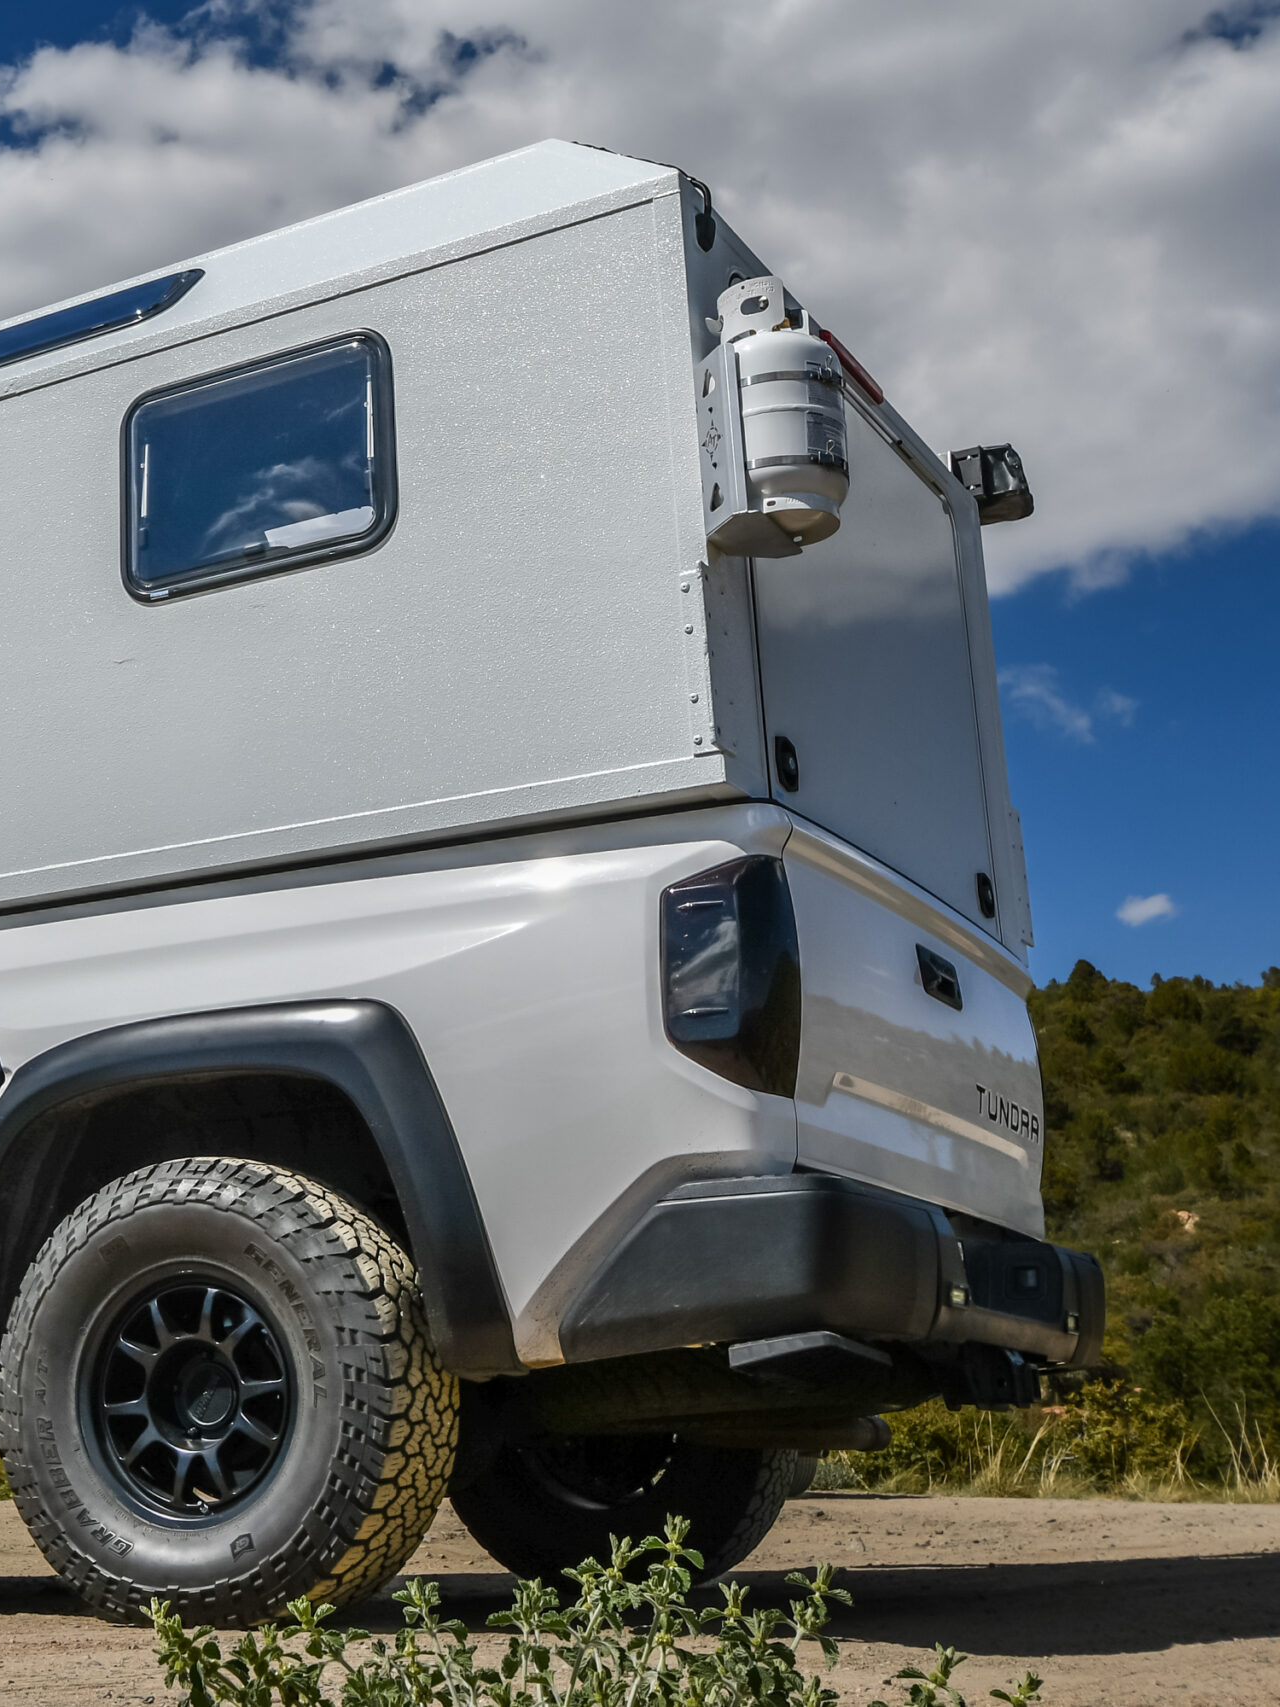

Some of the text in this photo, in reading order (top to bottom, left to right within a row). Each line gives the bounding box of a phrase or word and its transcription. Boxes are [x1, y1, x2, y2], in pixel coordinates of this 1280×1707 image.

[975, 1083, 1040, 1145] TUNDRA
[243, 1242, 328, 1409] GENERAL
[35, 1416, 135, 1558] GRABBER
